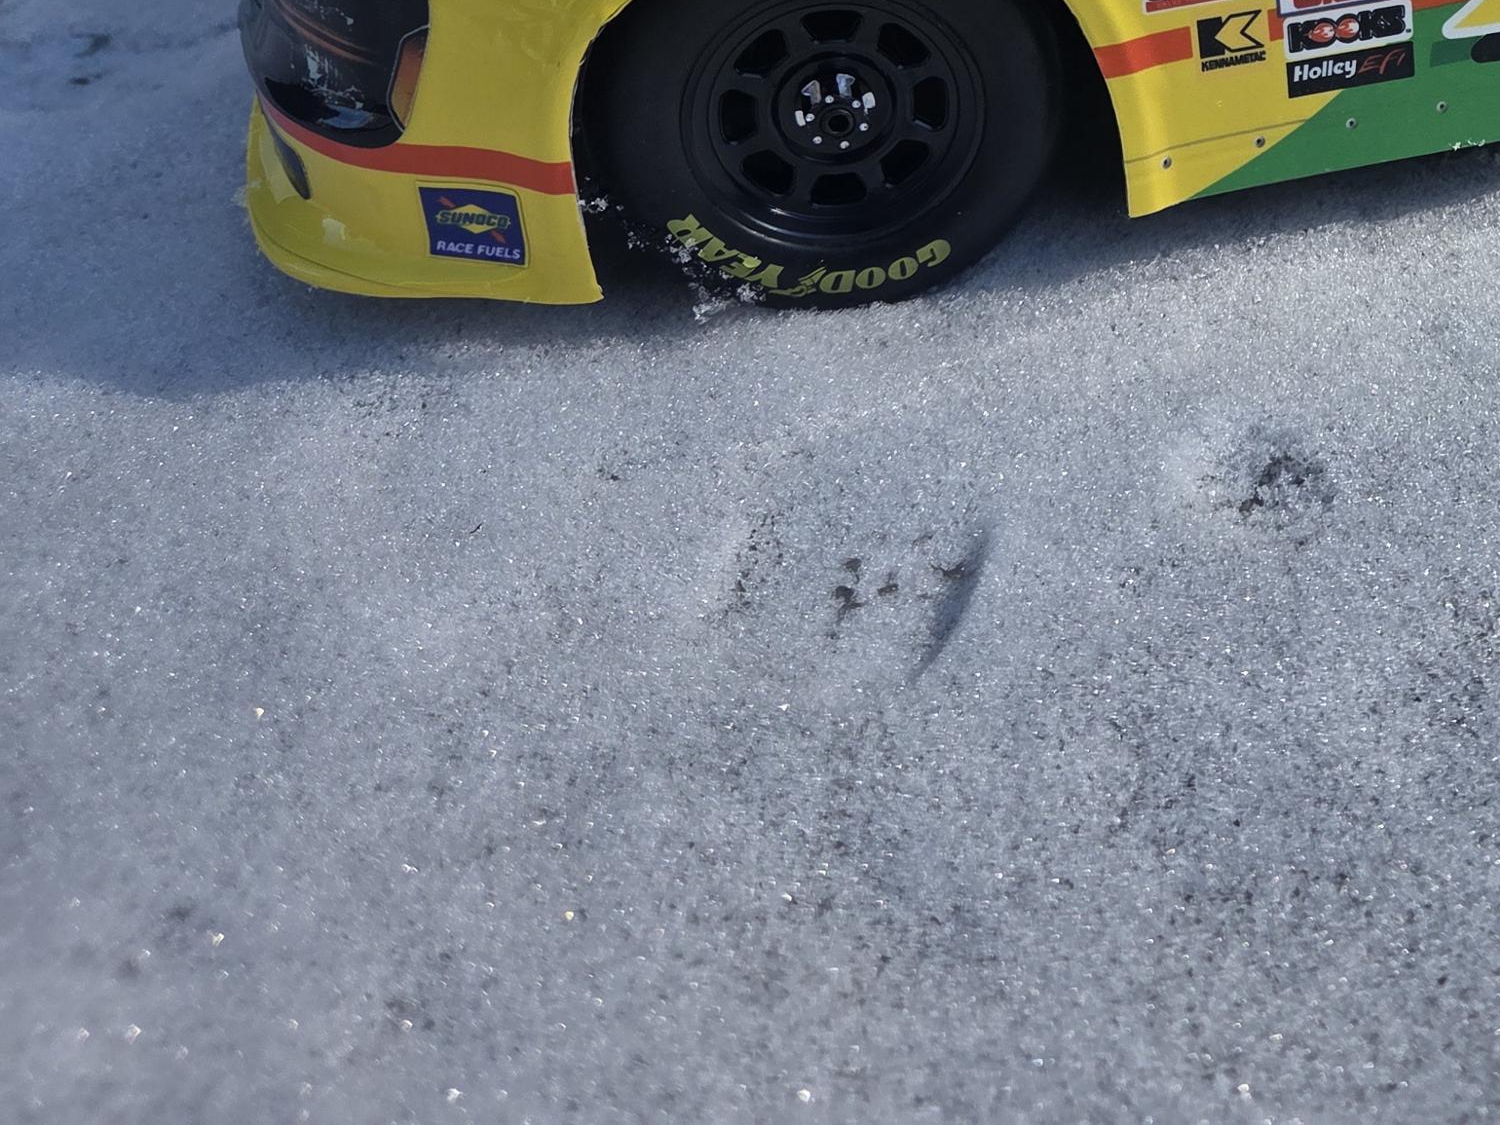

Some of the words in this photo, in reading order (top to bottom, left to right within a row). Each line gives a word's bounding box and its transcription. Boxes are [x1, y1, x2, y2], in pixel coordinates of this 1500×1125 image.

[1287, 4, 1406, 54] KOOKS
[1293, 59, 1357, 82] Holley
[437, 210, 511, 230] SUNOCO
[436, 240, 474, 254] RACE
[477, 244, 521, 260] FUELS
